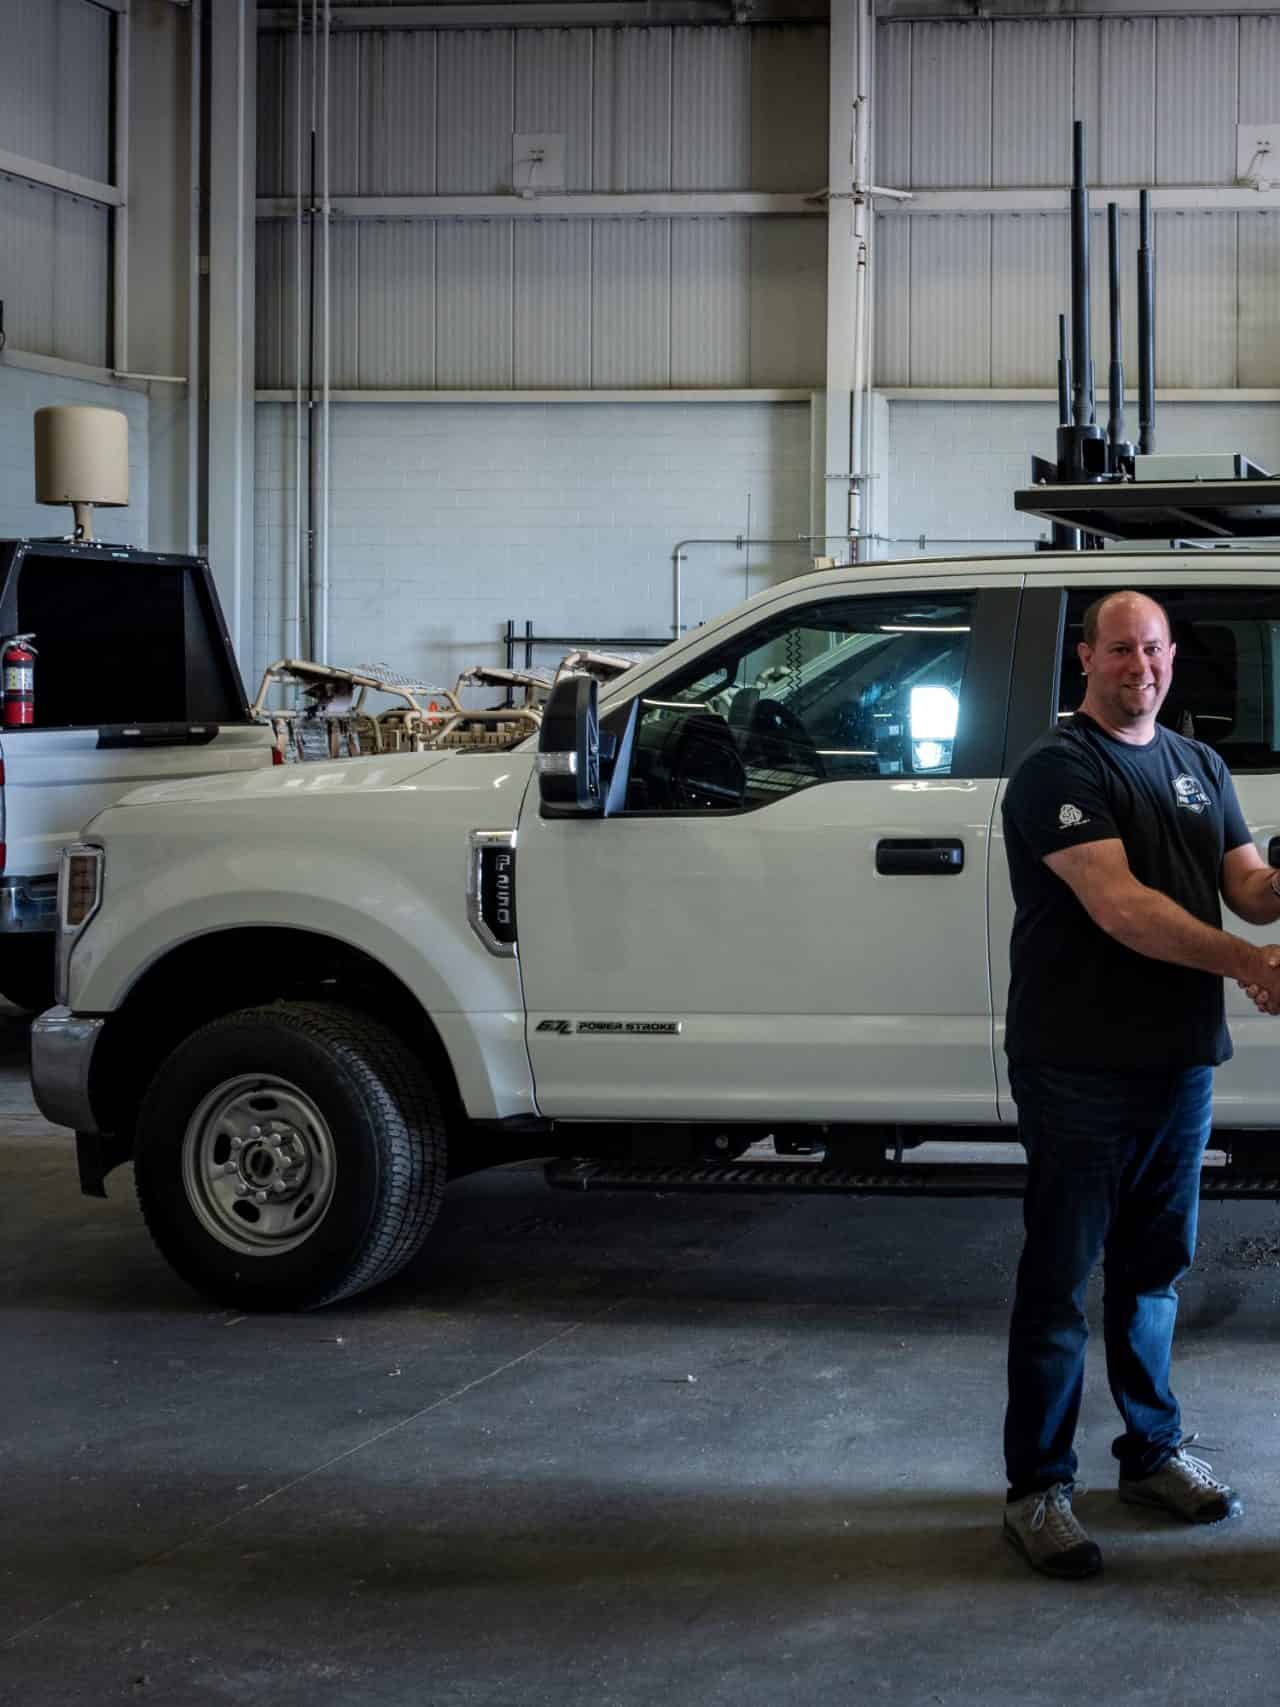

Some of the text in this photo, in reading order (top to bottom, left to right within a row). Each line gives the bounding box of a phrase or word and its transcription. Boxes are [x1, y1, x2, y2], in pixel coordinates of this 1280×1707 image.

[496, 854, 511, 924] F250
[577, 1021, 622, 1031] POWER
[626, 1021, 676, 1031] STROKE
